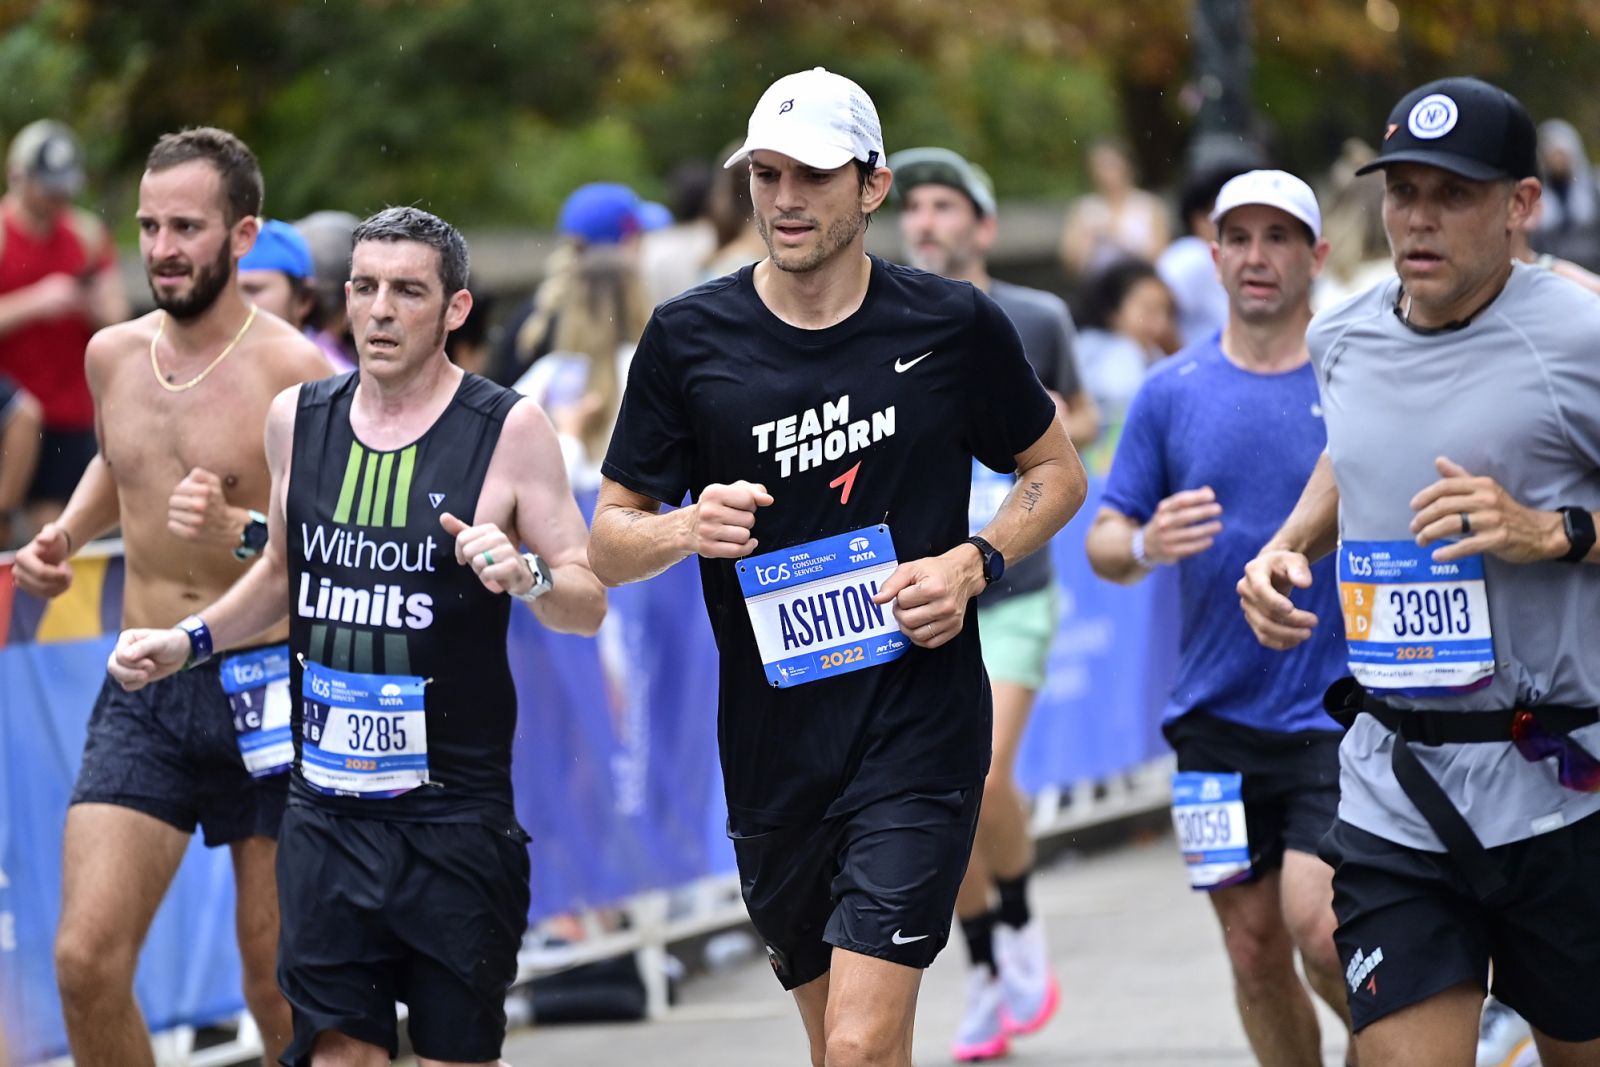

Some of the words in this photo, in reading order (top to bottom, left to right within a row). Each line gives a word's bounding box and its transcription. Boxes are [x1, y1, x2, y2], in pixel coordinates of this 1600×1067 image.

[752, 395, 849, 453] TEAM
[775, 406, 895, 478] THORN
[301, 522, 437, 572] Without
[790, 552, 810, 562] TATA
[849, 551, 876, 563] TATA
[791, 553, 837, 570] CONSULTANCY
[793, 565, 823, 577] SERVICES
[1348, 551, 1373, 577] tcs
[1430, 564, 1459, 575] TATA
[755, 562, 791, 586] tcs
[298, 571, 434, 630] Limits
[1390, 588, 1471, 636] 33913
[778, 580, 885, 650] ASHTON
[819, 646, 865, 670] 2022
[1396, 646, 1435, 660] 2022
[378, 697, 404, 706] TATA
[311, 725, 320, 741] B
[348, 714, 407, 752] 3285
[346, 758, 377, 770] 2022
